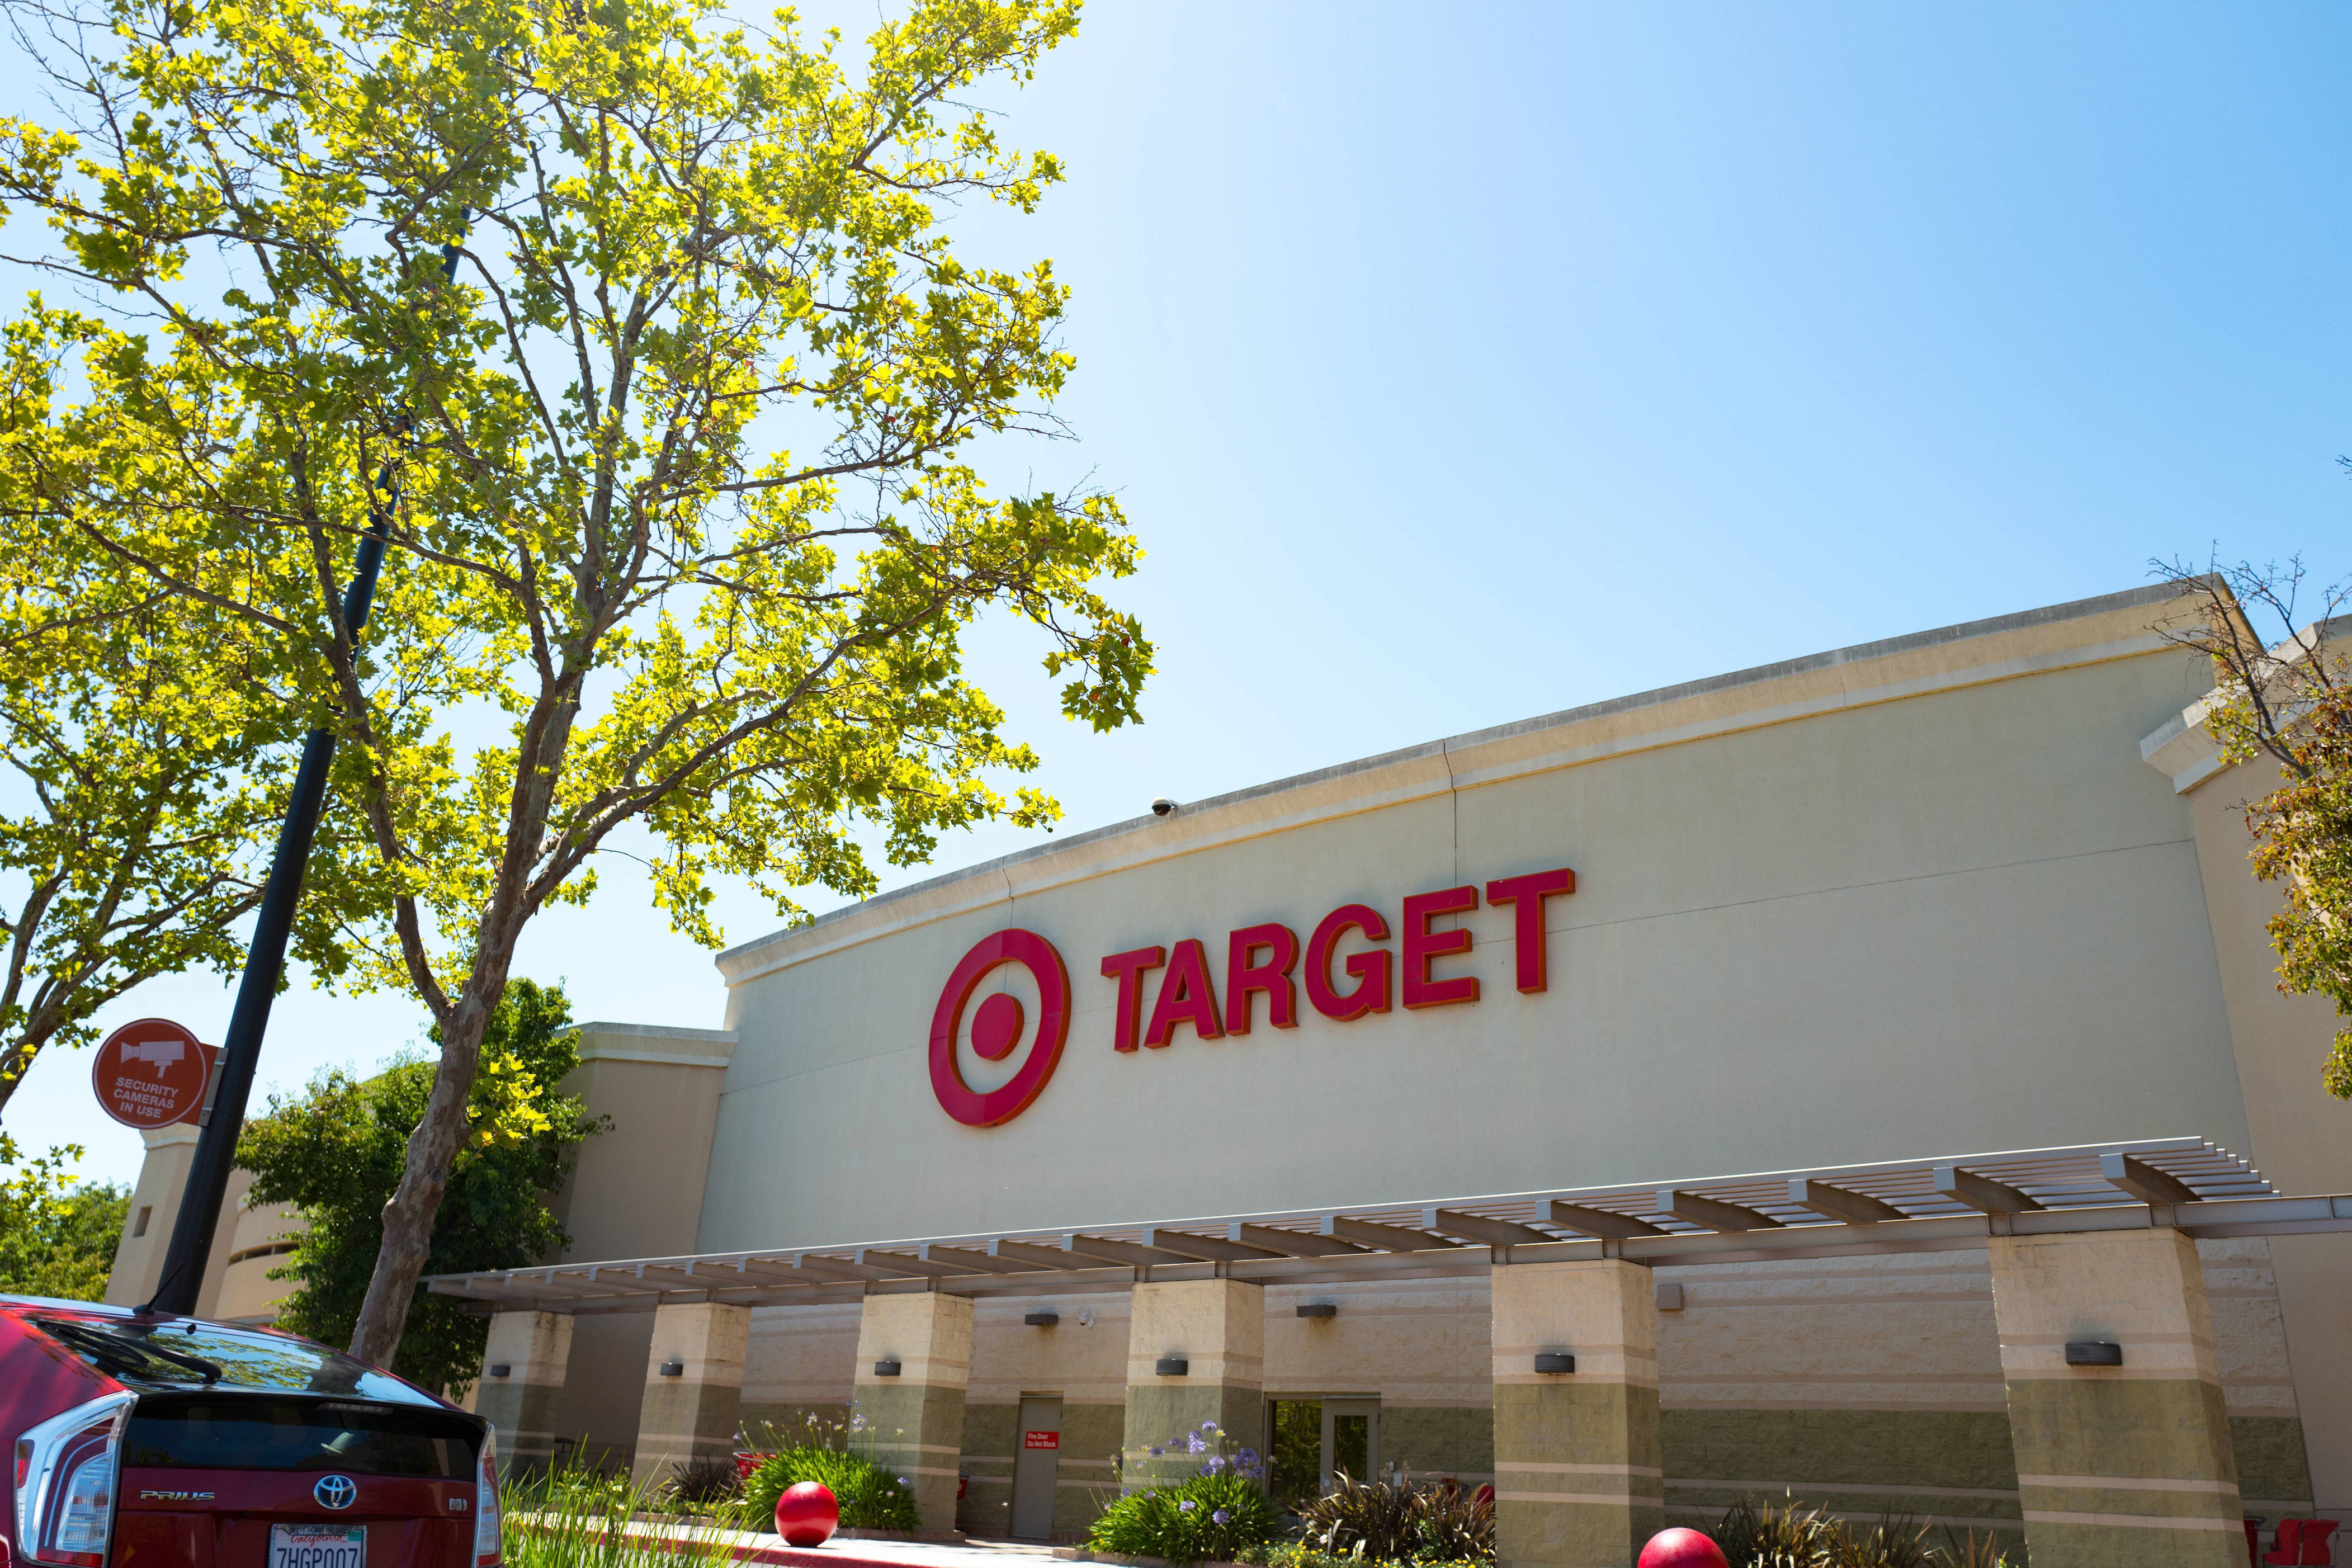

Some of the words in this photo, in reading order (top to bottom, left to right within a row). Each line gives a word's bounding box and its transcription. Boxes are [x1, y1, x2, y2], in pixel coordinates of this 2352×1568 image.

[1101, 868, 1575, 1053] TARGET
[116, 1076, 179, 1098] SECURITY
[114, 1089, 174, 1109] CAMERAS
[120, 1102, 134, 1113] IN
[136, 1104, 162, 1118] USE
[140, 1490, 215, 1500] PRIUS
[290, 1534, 348, 1547] California
[277, 1547, 358, 1568] 7HGP007
